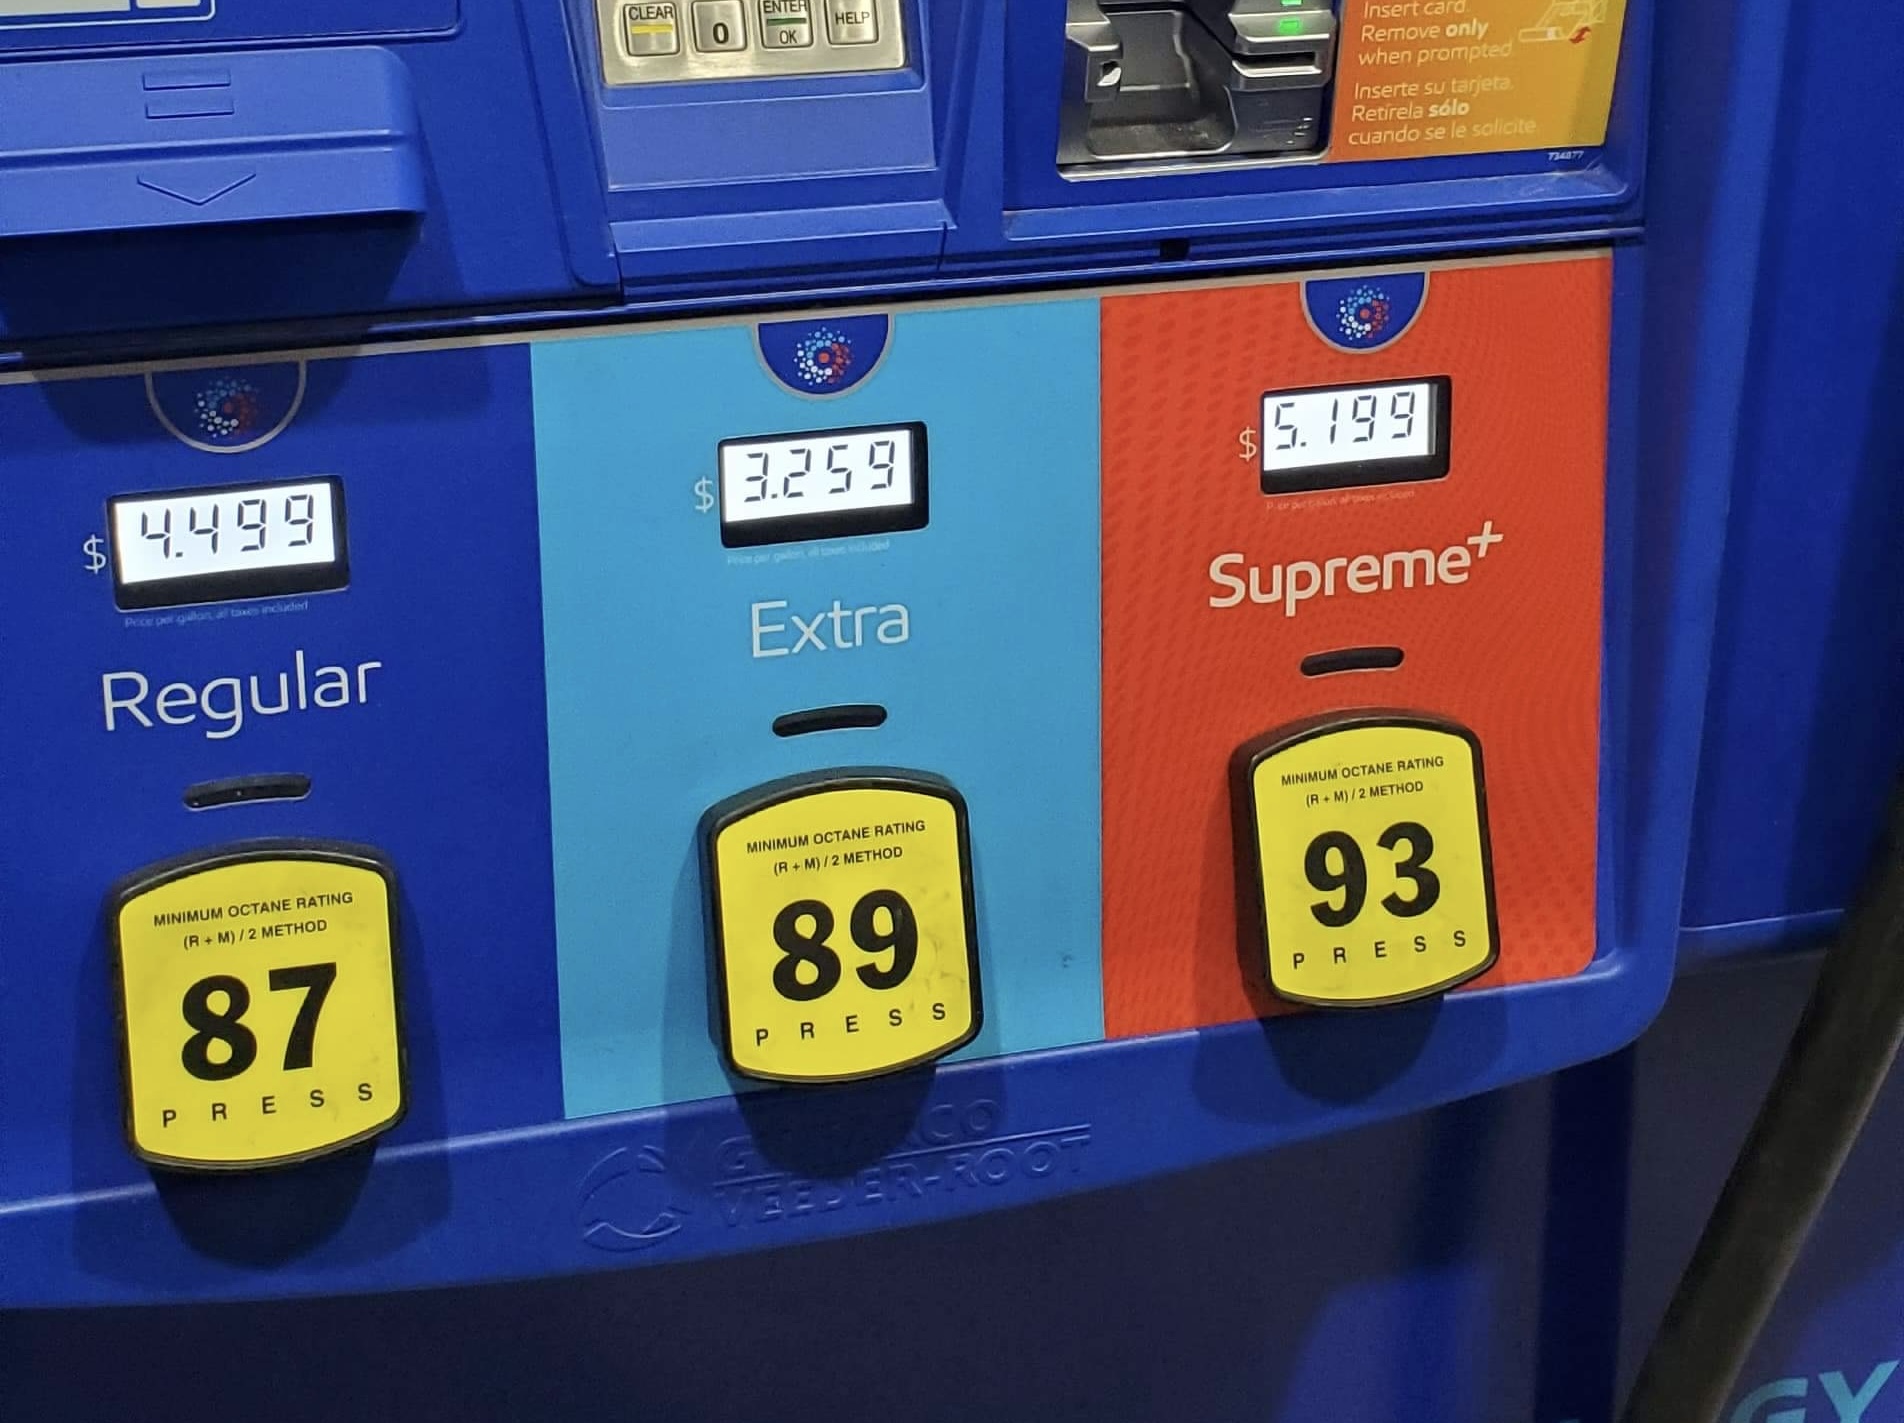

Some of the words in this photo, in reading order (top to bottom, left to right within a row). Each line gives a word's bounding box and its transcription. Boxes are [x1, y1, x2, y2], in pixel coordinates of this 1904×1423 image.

[628, 5, 674, 20] CLEAR
[763, 0, 808, 14] ENTER
[834, 10, 871, 26] HELP
[1363, 0, 1419, 19] Insert
[712, 22, 730, 45] 0
[780, 29, 799, 45] OK
[1361, 24, 1441, 43] Remove
[1445, 17, 1489, 41] only
[1358, 47, 1412, 66] when
[1417, 39, 1513, 67] prompted
[1354, 82, 1420, 100] Inserte
[1424, 82, 1446, 95] su
[1428, 98, 1471, 118] sólo
[1348, 124, 1421, 146] cuando
[1424, 126, 1446, 141] se
[1450, 119, 1468, 139] le
[1472, 115, 1538, 138] solicite
[1238, 427, 1258, 462] $
[1274, 391, 1416, 451] 5.199
[694, 476, 715, 513] $
[744, 440, 896, 502] 3.259
[82, 534, 107, 574] $
[140, 494, 315, 560] 4.499
[751, 600, 910, 658] Extra
[101, 649, 383, 738] Regular
[1281, 769, 1338, 786] MINIMUM
[1341, 762, 1394, 777] OCTANE
[1397, 756, 1444, 770] RATING
[1359, 788, 1366, 799] 2
[1369, 780, 1424, 797] METHOD
[747, 834, 809, 853] MINIMUM
[813, 827, 870, 844] OCTANE
[875, 820, 926, 836] RATING
[831, 855, 840, 866] 2
[843, 846, 902, 864] METHOD
[1304, 821, 1441, 928] 93
[153, 906, 223, 927] MINIMUM
[228, 899, 292, 918] OCTANE
[296, 892, 353, 908] RATING
[248, 928, 257, 940] 2
[261, 919, 328, 938] METHOD
[772, 889, 918, 1002] 89
[181, 961, 337, 1082] 87
